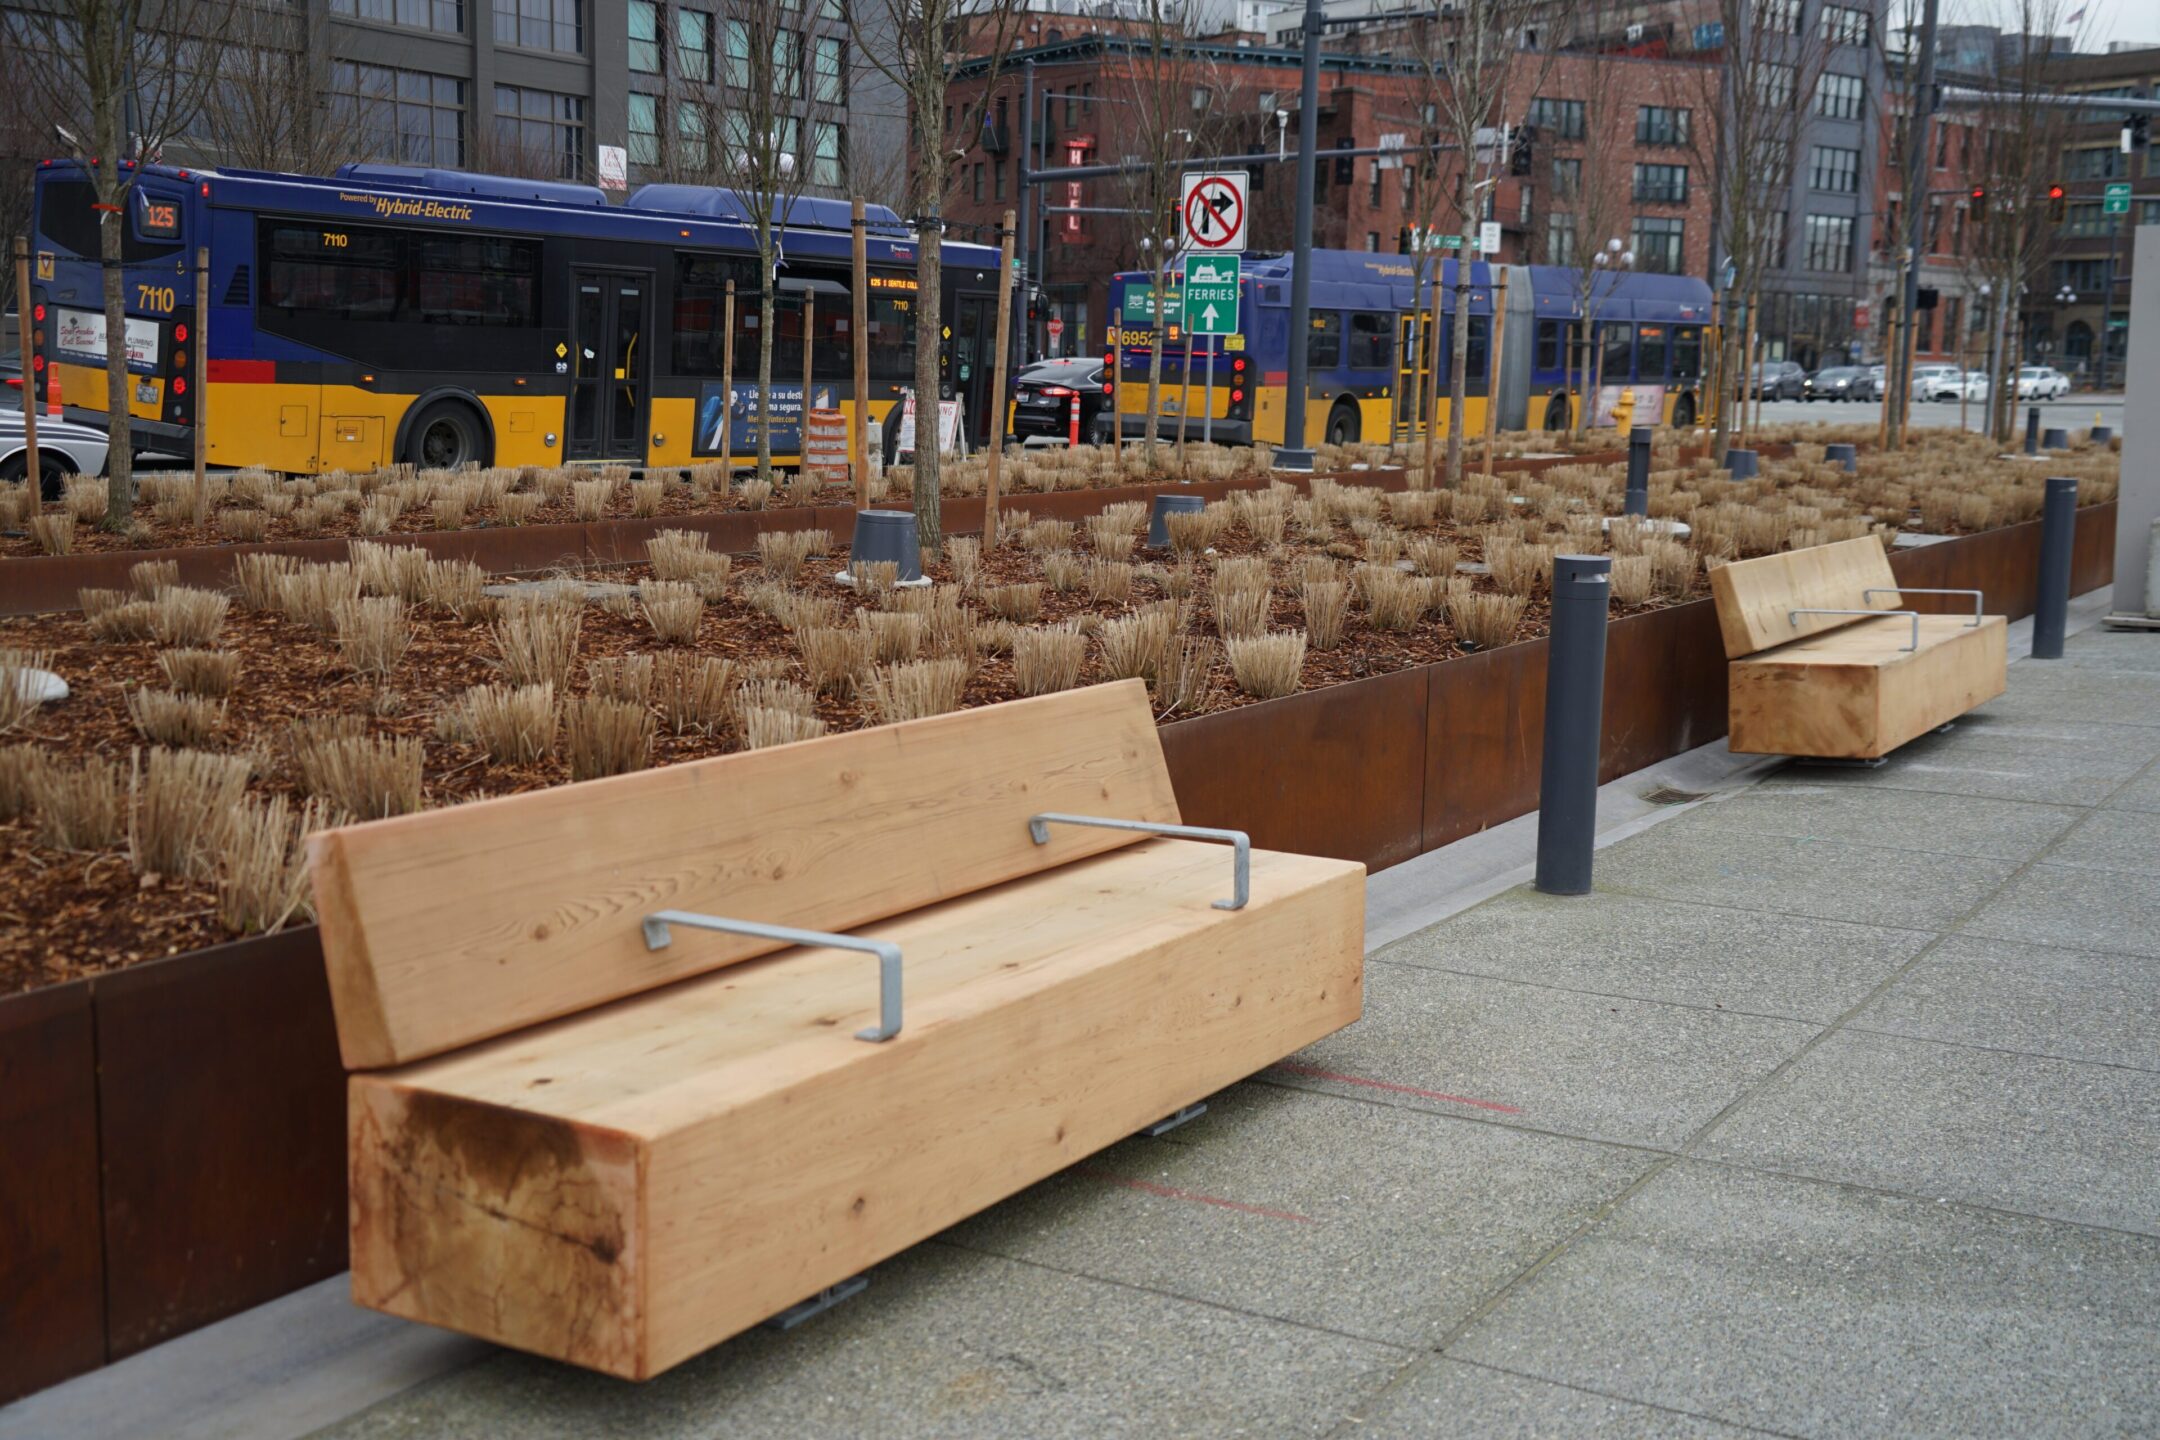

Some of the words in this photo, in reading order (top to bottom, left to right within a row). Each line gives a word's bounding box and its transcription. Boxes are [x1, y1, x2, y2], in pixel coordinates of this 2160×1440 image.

[1070, 149, 1081, 231] HTEL
[340, 192, 369, 203] Powered
[369, 195, 377, 205] by
[376, 197, 473, 221] Hybrid-Electric
[148, 206, 174, 227] 125
[323, 233, 348, 247] 7110
[138, 284, 175, 313] 7110
[1188, 289, 1235, 301] FERRIES
[893, 300, 909, 311] 7110
[127, 337, 154, 347] PLUMBING
[778, 392, 786, 400] su
[787, 390, 803, 400] desti
[748, 402, 758, 411] de
[779, 404, 803, 414] segura.
